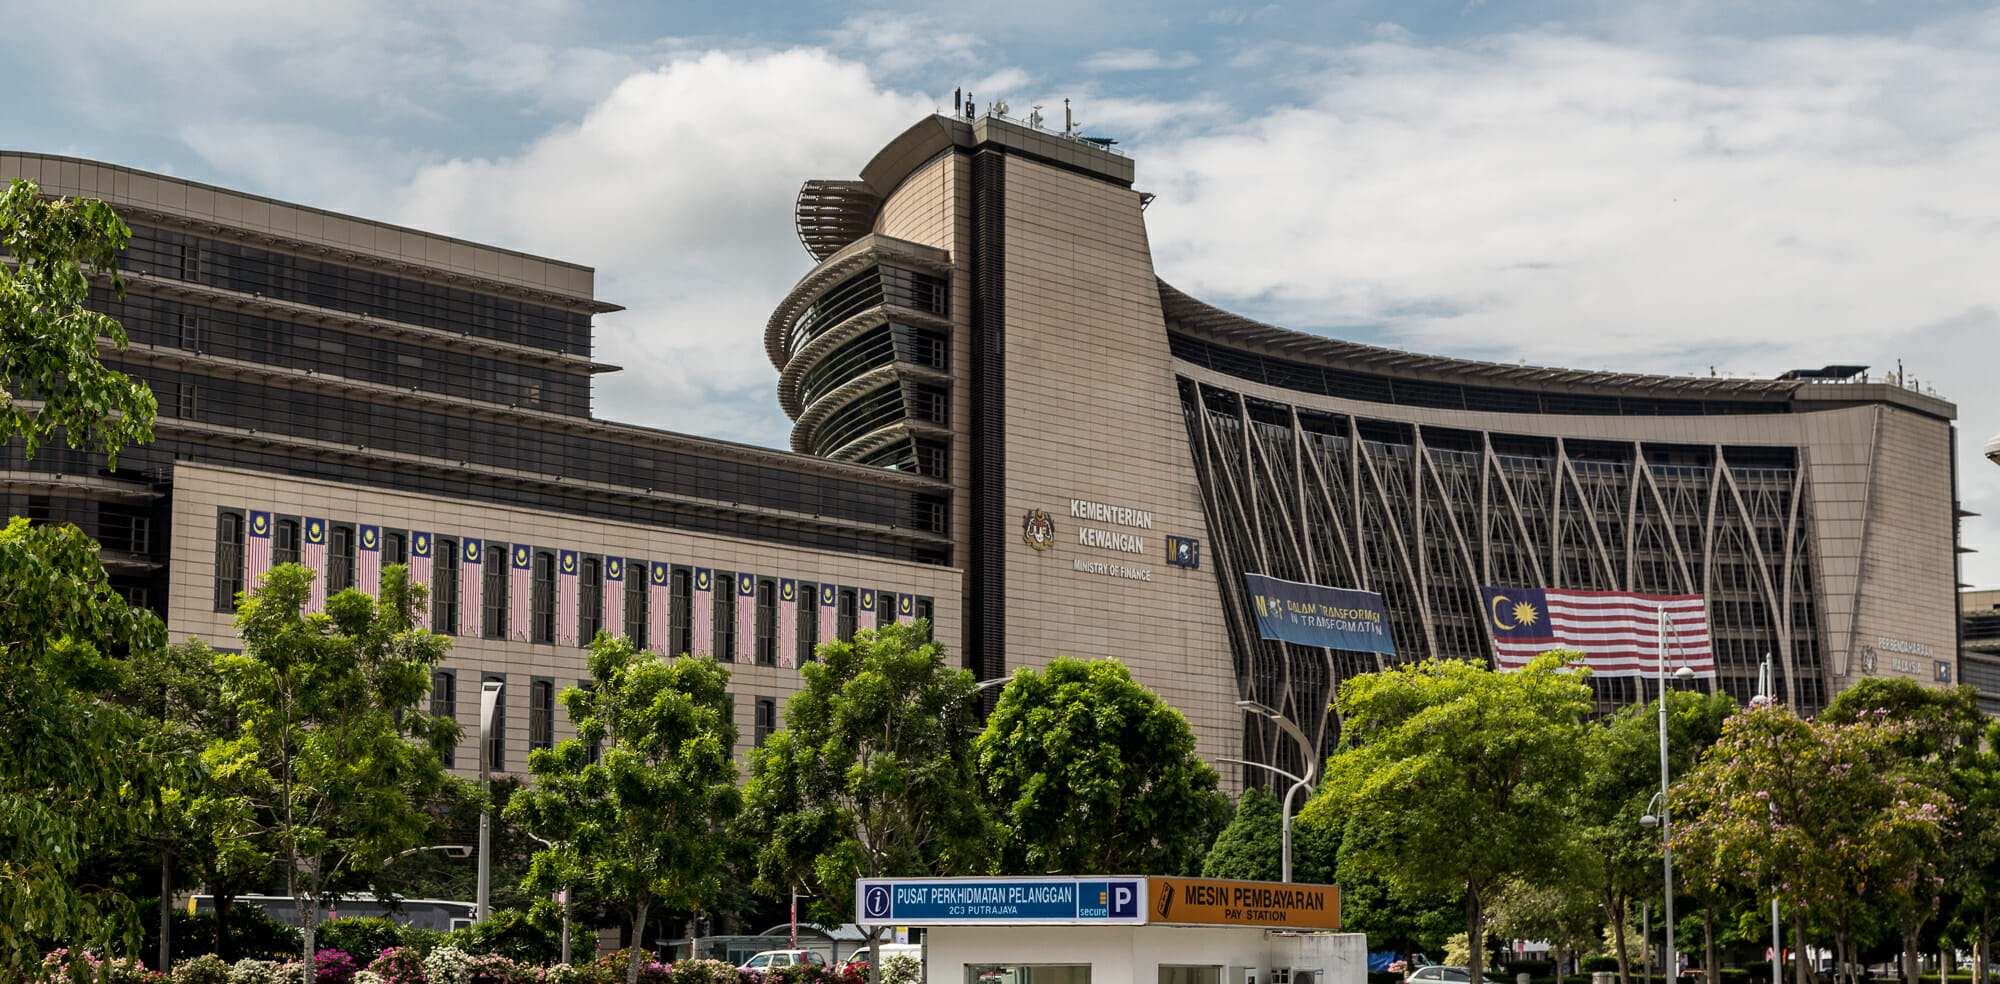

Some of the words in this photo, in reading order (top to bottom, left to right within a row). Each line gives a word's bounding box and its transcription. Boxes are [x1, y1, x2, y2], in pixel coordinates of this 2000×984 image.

[1071, 499, 1151, 528] KEMENTERIAN
[1079, 527, 1144, 554] KEWANGAN
[1074, 559, 1108, 574] MINISTRY
[1110, 565, 1119, 576] OF
[1121, 566, 1150, 581] FINANCE
[1287, 600, 1316, 615] DALAM
[1319, 604, 1380, 623] TRANSFORMSI
[1892, 658, 1920, 675] MALAYSIA
[897, 888, 928, 904] PUSAT
[931, 887, 1005, 904] PERKHIDMATAN
[1008, 887, 1072, 904] PELANGGAN
[1115, 887, 1132, 913] P
[1185, 885, 1229, 906] MESIN
[1233, 888, 1324, 910] PEMBAYARAN
[949, 906, 965, 915] 2C3
[968, 905, 1018, 915] PUTRAJAYA
[1080, 908, 1107, 916] secure
[1225, 909, 1242, 920] PAY
[1246, 910, 1287, 922] STATION
